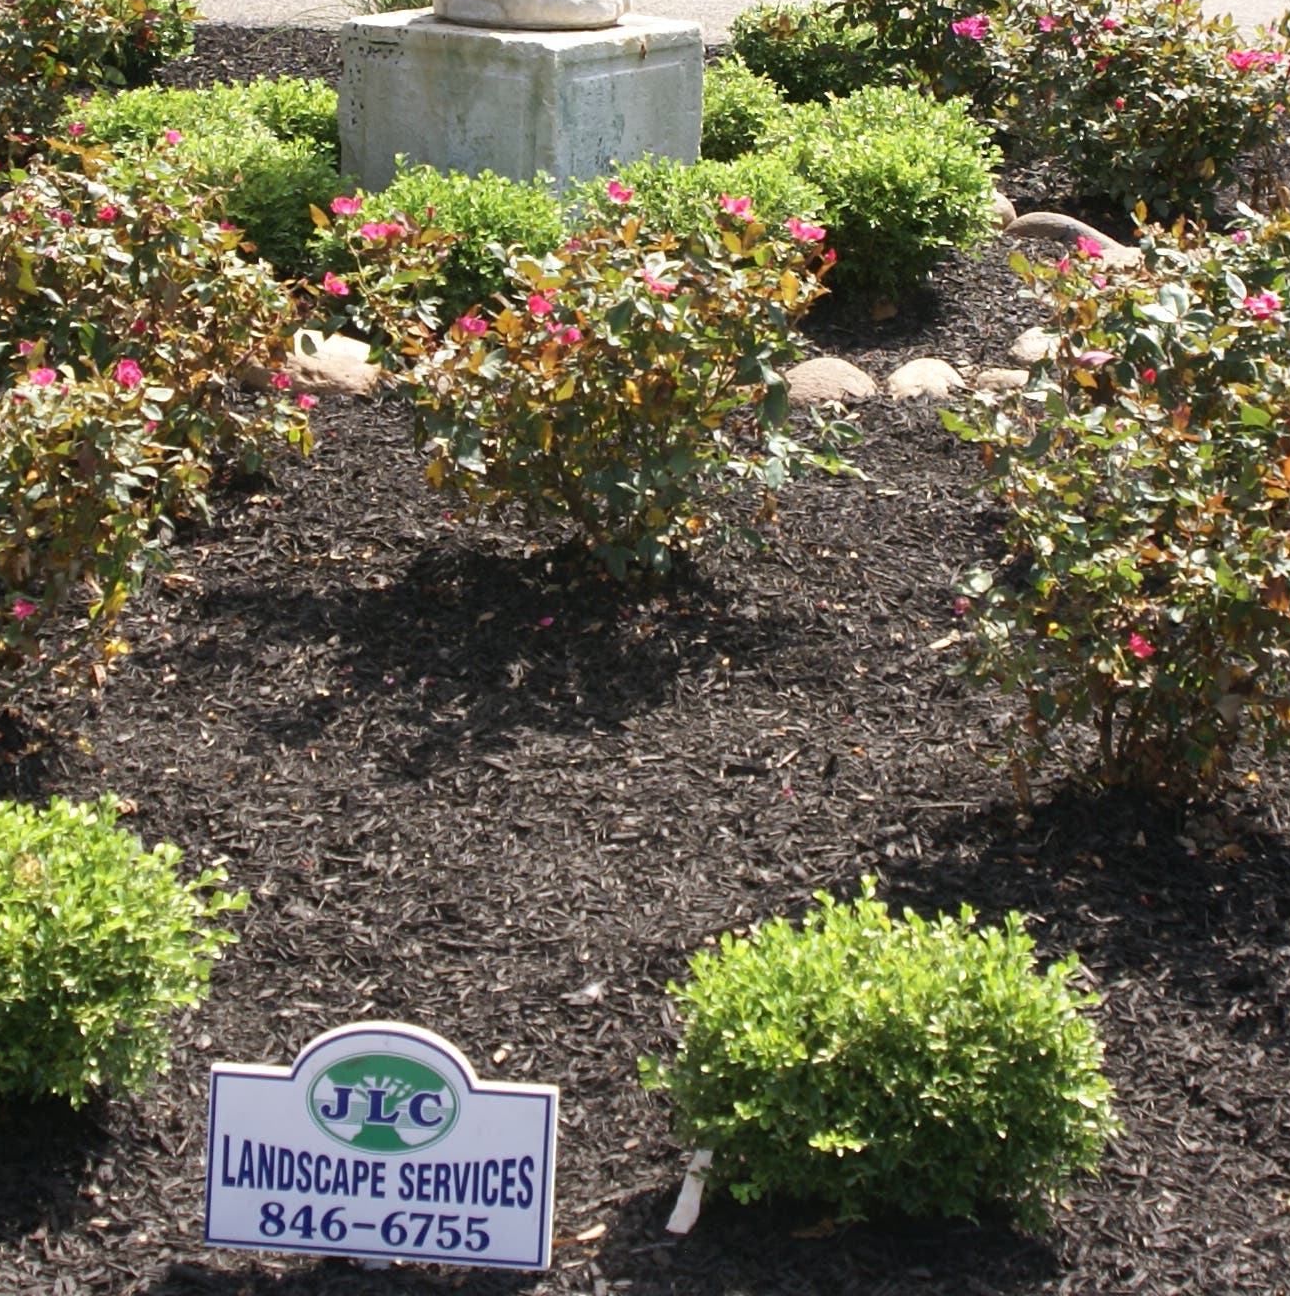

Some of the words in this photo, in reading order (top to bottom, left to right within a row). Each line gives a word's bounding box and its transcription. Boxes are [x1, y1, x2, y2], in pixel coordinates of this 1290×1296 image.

[321, 1086, 444, 1127] JLC
[221, 1134, 386, 1199] LANDSCAPE
[399, 1155, 535, 1209] SERVICES
[259, 1201, 491, 1253] 846-6755
